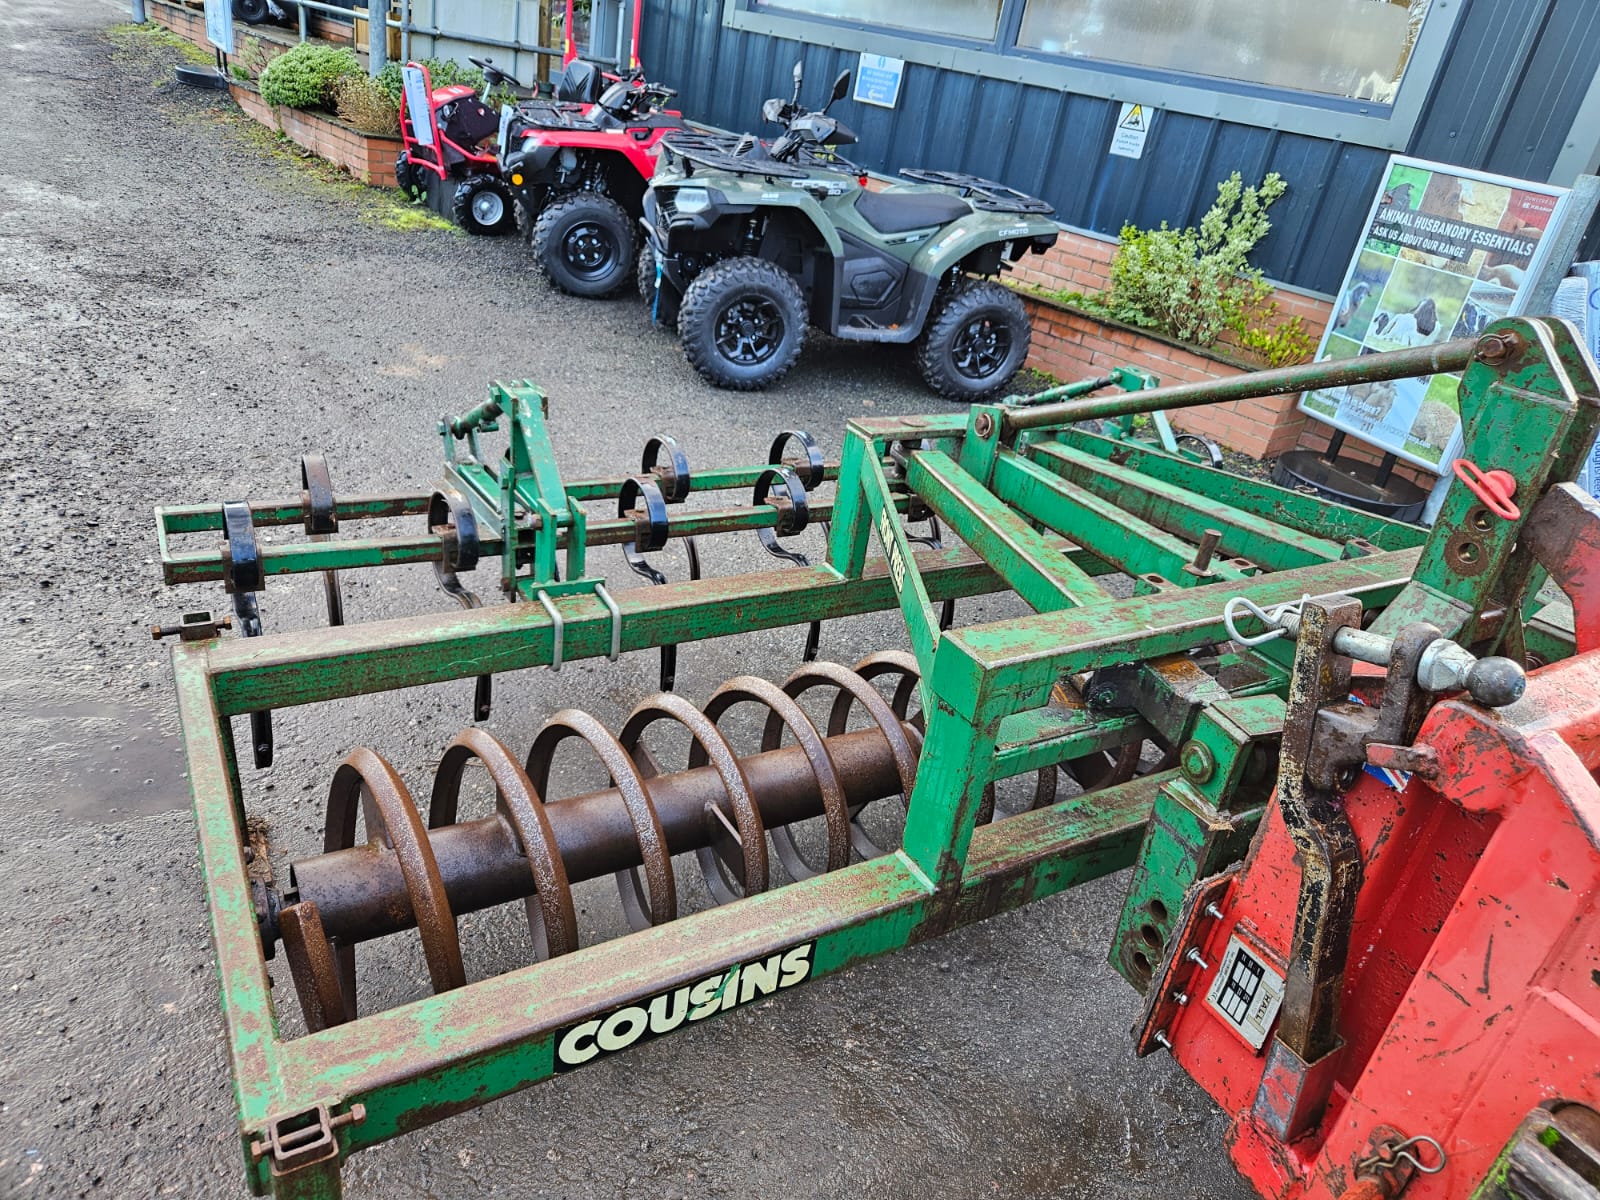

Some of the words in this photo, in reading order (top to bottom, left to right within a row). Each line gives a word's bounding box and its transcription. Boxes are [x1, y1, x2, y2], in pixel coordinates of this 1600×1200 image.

[998, 227, 1029, 237] CFMOTO
[1373, 225, 1389, 237] ASK
[1388, 229, 1399, 239] US
[1396, 231, 1424, 247] ABOUT
[1422, 238, 1440, 251] OUR
[1438, 242, 1466, 258] RANGE
[1379, 207, 1413, 227] ANIMAL
[1414, 214, 1472, 242] HUSBANDRY
[1470, 229, 1535, 257] ESSENTIALS
[558, 943, 812, 1065] COUSINS
[1255, 993, 1272, 1024] HALL
